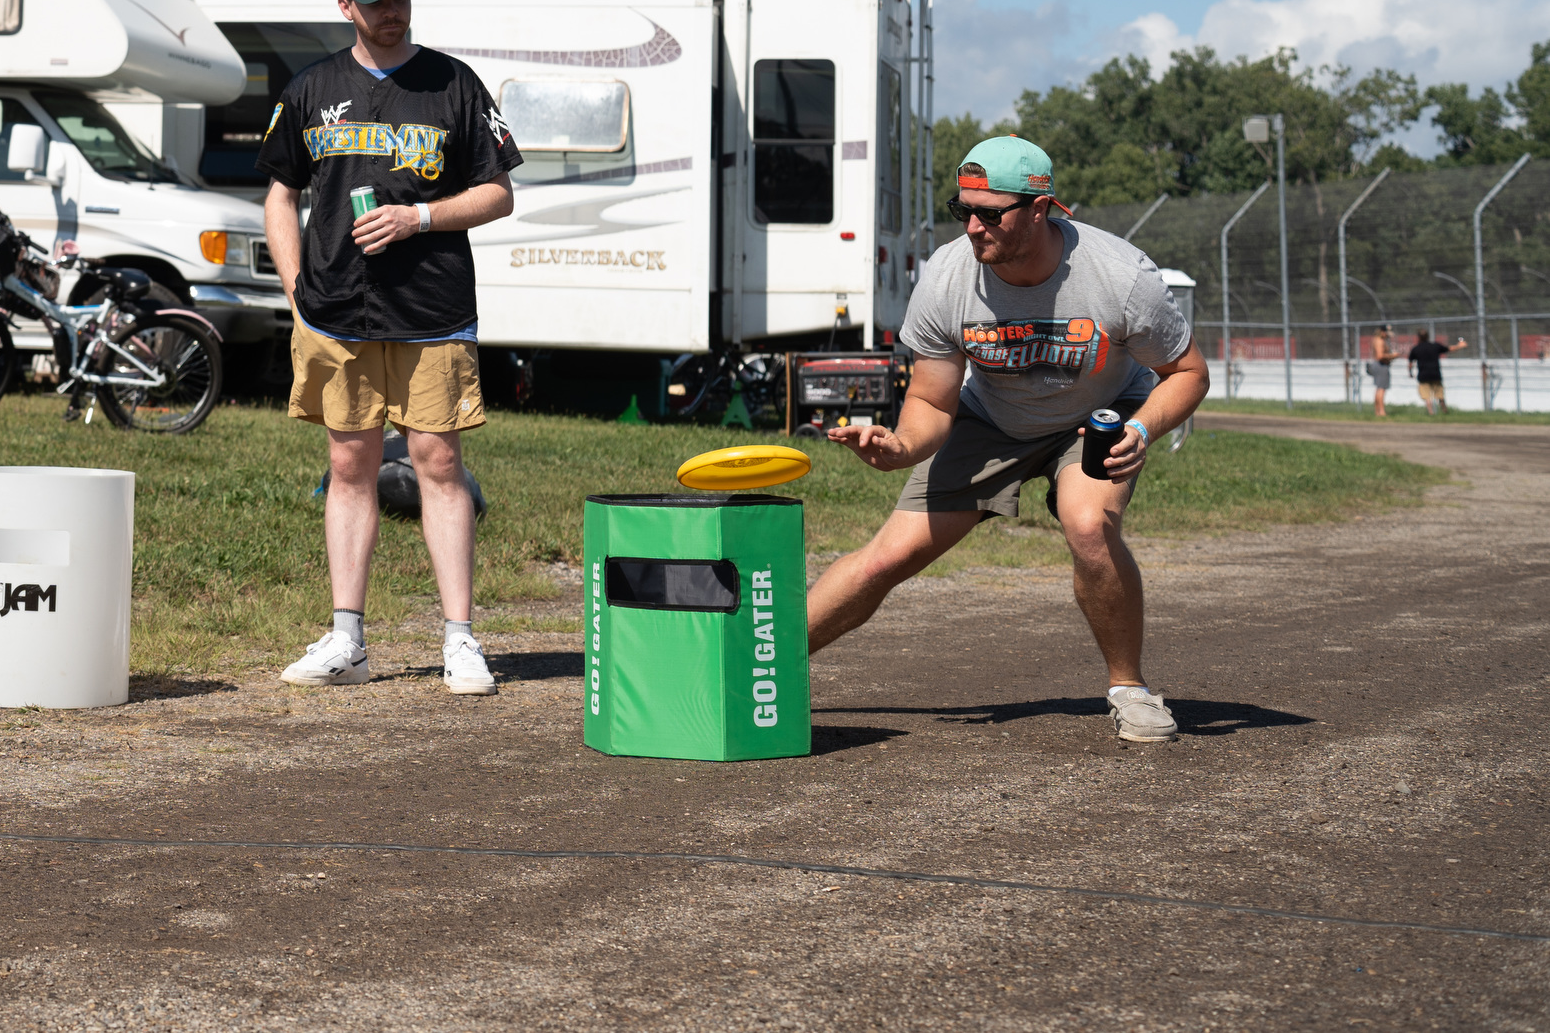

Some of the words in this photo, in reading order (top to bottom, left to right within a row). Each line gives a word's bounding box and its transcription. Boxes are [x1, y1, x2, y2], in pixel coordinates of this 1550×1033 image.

[510, 247, 667, 271] SILVERBACK
[963, 324, 1034, 343] HOOTERS
[1023, 333, 1047, 342] NIGHT
[1048, 335, 1066, 343] OWL
[1066, 318, 1095, 343] 9
[974, 347, 1009, 361] CHASE
[1006, 341, 1088, 367] ELLIOTT
[0, 582, 57, 618] JAM
[592, 561, 601, 652] GATER
[752, 569, 777, 662] GATER
[590, 655, 600, 716] GO!
[753, 667, 778, 728] GO!
